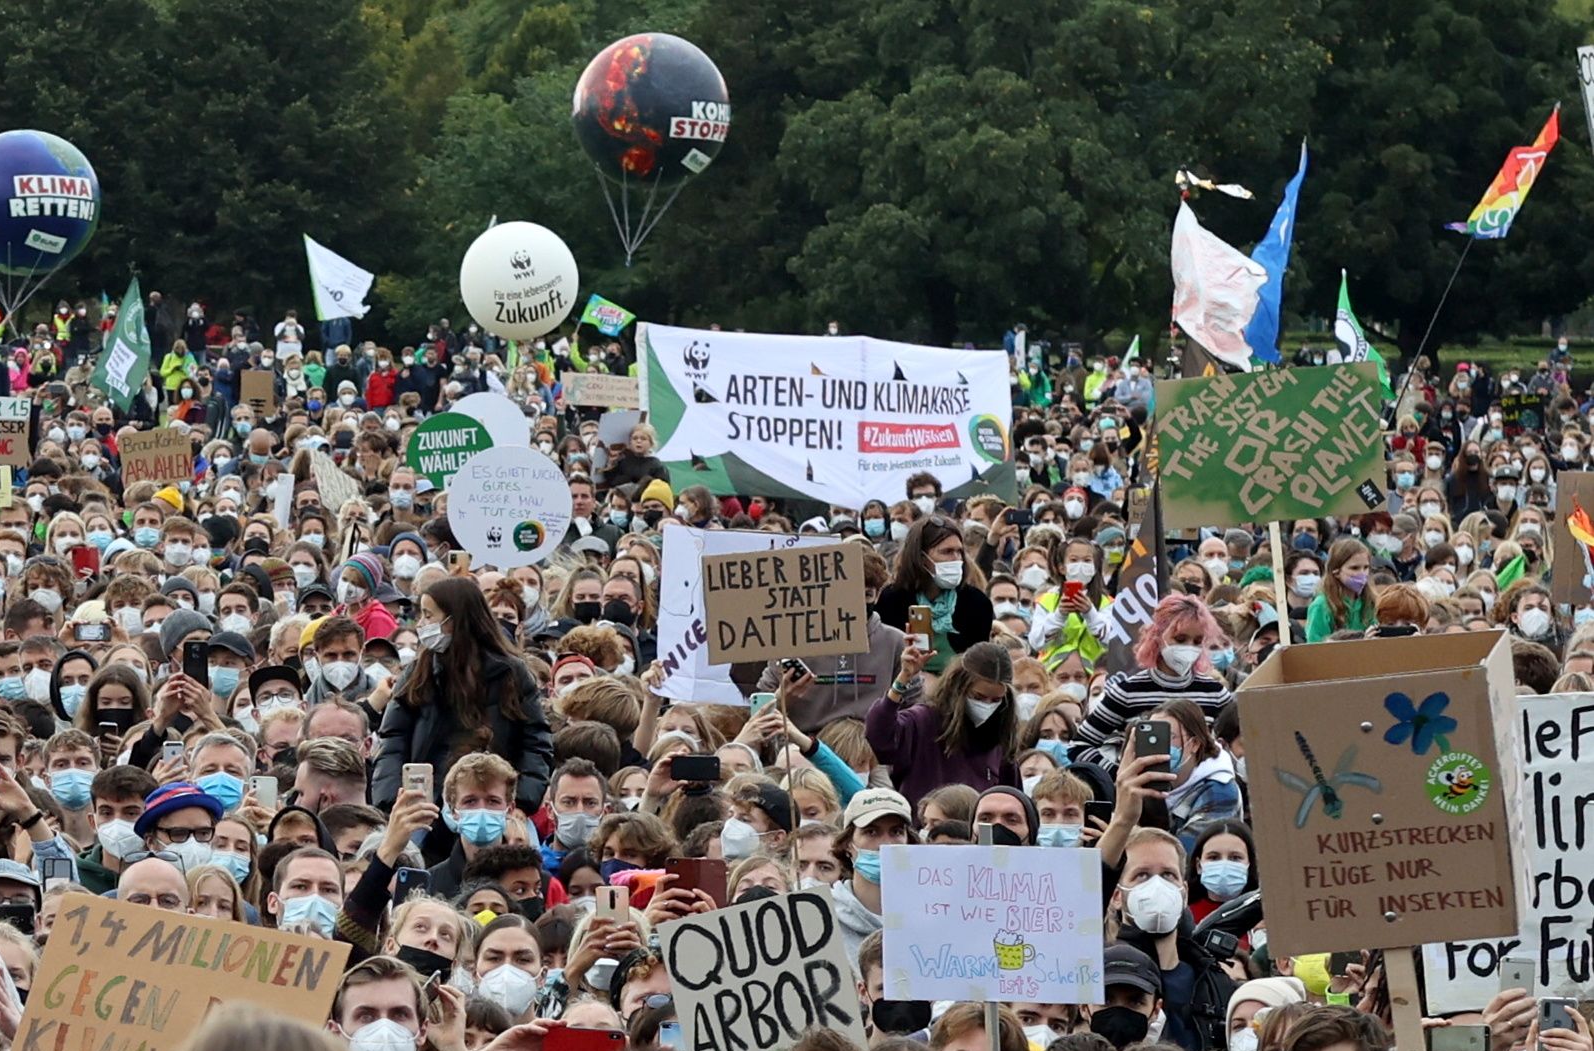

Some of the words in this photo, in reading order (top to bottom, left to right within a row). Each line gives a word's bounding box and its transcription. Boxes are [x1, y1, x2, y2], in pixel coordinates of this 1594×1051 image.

[18, 177, 90, 196] KLIMA
[9, 197, 95, 221] RETTEN!
[494, 289, 568, 324] Zukunft.
[725, 374, 814, 408] ARTEN-
[821, 378, 867, 411] UND
[873, 383, 971, 416] KLIMAKRISE
[1156, 375, 1238, 443] TRASH
[417, 427, 478, 451] ZUKUNFT
[727, 411, 843, 450] STOPPEN!
[1161, 431, 1219, 481] THE
[1212, 368, 1299, 436] SYSTEM
[1223, 409, 1291, 476] OR
[1238, 410, 1329, 516] CRASH
[1311, 365, 1359, 414] THE
[858, 459, 871, 471] Für
[872, 460, 889, 471] eine
[934, 454, 962, 466] Zukunft
[1289, 386, 1382, 509] PLANET
[471, 465, 492, 480] ES
[495, 466, 529, 480] GIBT
[482, 480, 521, 492] GUTES
[480, 506, 506, 517] TUT
[707, 555, 788, 593] LIEBER
[798, 550, 848, 583] BIER
[764, 582, 831, 610] STATT
[661, 617, 709, 678] NICE
[1426, 752, 1483, 785] ACKERGIFTE?
[1432, 795, 1459, 813] NEIN
[1462, 779, 1490, 813] DANKE!
[1316, 821, 1496, 855] KURZSTRECKEN
[917, 865, 955, 887] DAS
[966, 863, 1058, 904] KLIMA
[1303, 860, 1374, 889] FLÜGE
[1385, 857, 1442, 883] NUR
[925, 903, 952, 916] IST
[960, 903, 997, 923] WIE
[1006, 905, 1075, 933] BIER:
[1307, 896, 1357, 922] FÜR
[1378, 886, 1506, 916] INSEKTEN
[64, 904, 128, 956] 1,4
[127, 919, 332, 992] MILIONEN
[667, 892, 835, 991] QUOD
[1539, 915, 1594, 987] Fu
[909, 943, 999, 980] WARM
[43, 964, 181, 1033] GEGEN
[998, 978, 1040, 998] ist's
